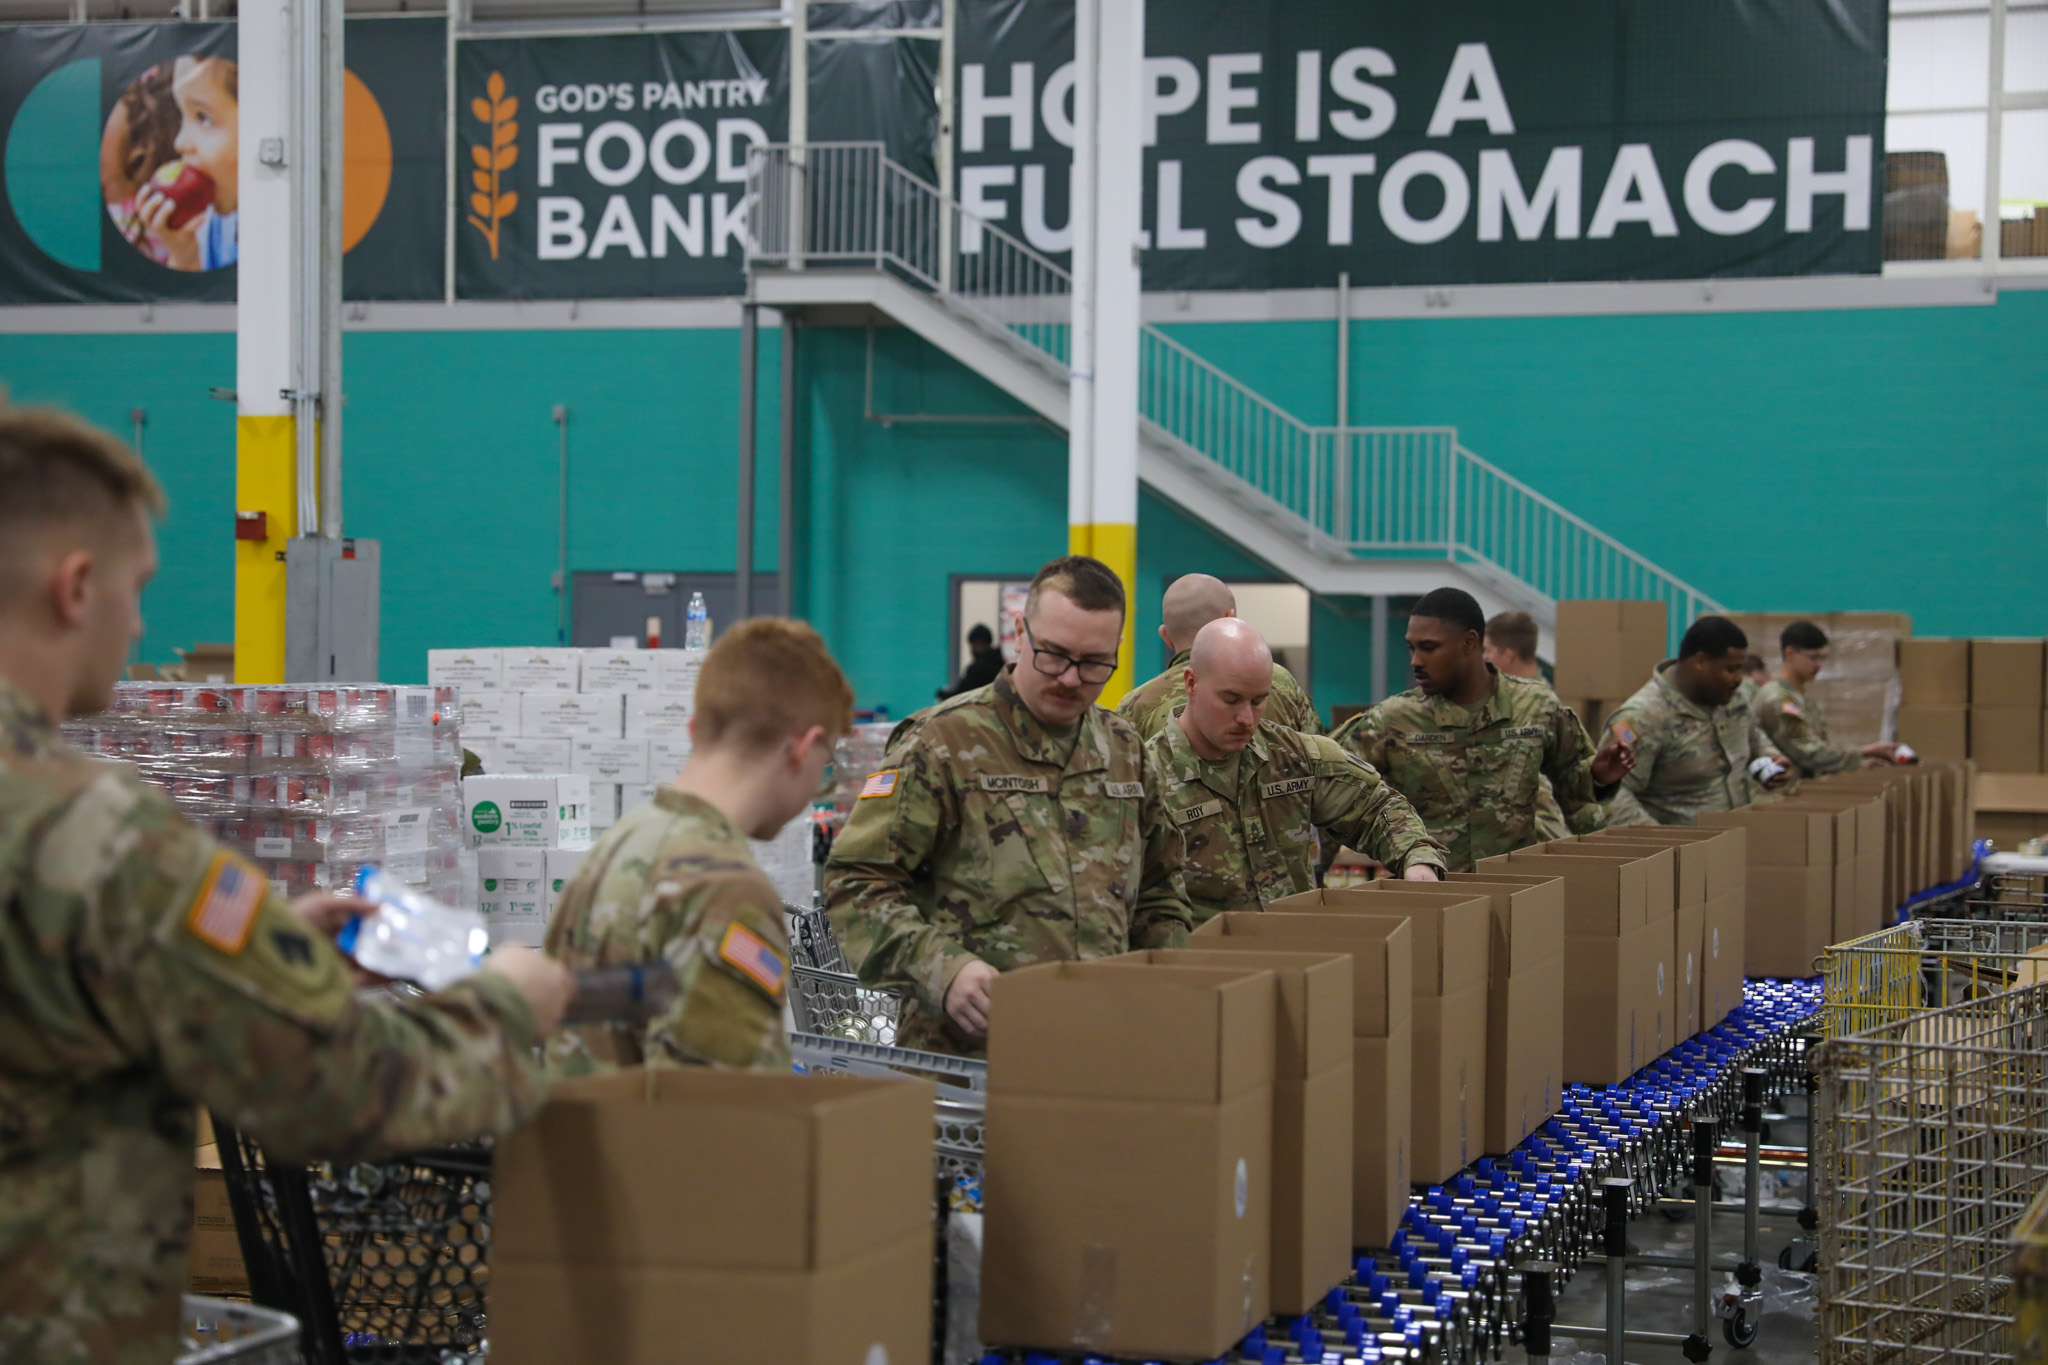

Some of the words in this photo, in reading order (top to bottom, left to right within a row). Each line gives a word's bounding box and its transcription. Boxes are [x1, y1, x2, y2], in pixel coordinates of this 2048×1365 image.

[535, 83, 636, 113] GOD'S
[642, 78, 770, 111] PANTRY
[1296, 46, 1398, 141] IS
[1426, 42, 1516, 138] A
[537, 117, 769, 188] FOOD
[959, 159, 1207, 255] FUL
[1235, 134, 1873, 248] STOMACH
[536, 193, 762, 261] BANK
[1414, 733, 1446, 742] DARDEN
[986, 777, 1039, 790] MCINTOSH
[1267, 784, 1284, 796] U.S.
[1286, 779, 1309, 793] ARMY
[1186, 806, 1205, 821] ROY
[481, 902, 491, 912] 12
